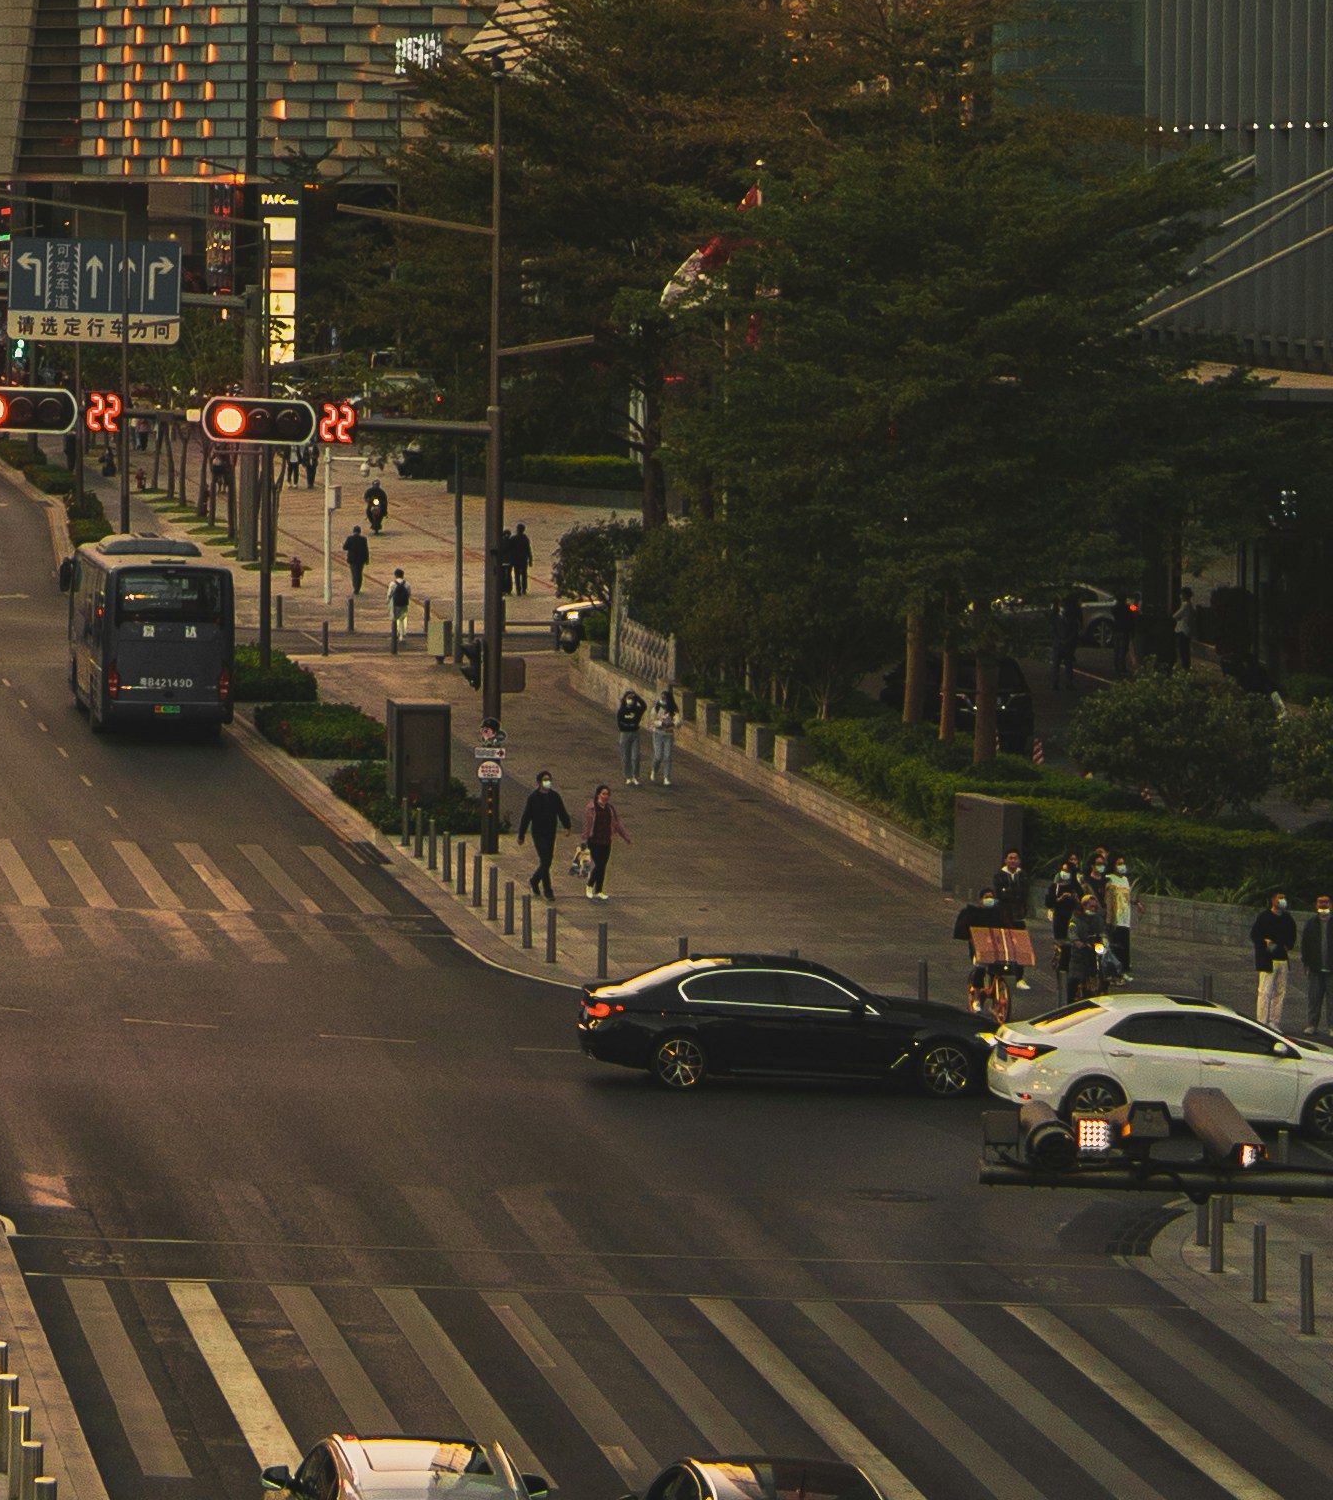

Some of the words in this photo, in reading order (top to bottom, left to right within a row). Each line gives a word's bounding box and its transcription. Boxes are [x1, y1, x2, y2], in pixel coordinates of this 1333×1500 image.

[55, 243, 71, 309] 可变车道
[17, 315, 171, 340] 请选定行车方向
[86, 392, 122, 432] 22
[319, 402, 355, 444] 22
